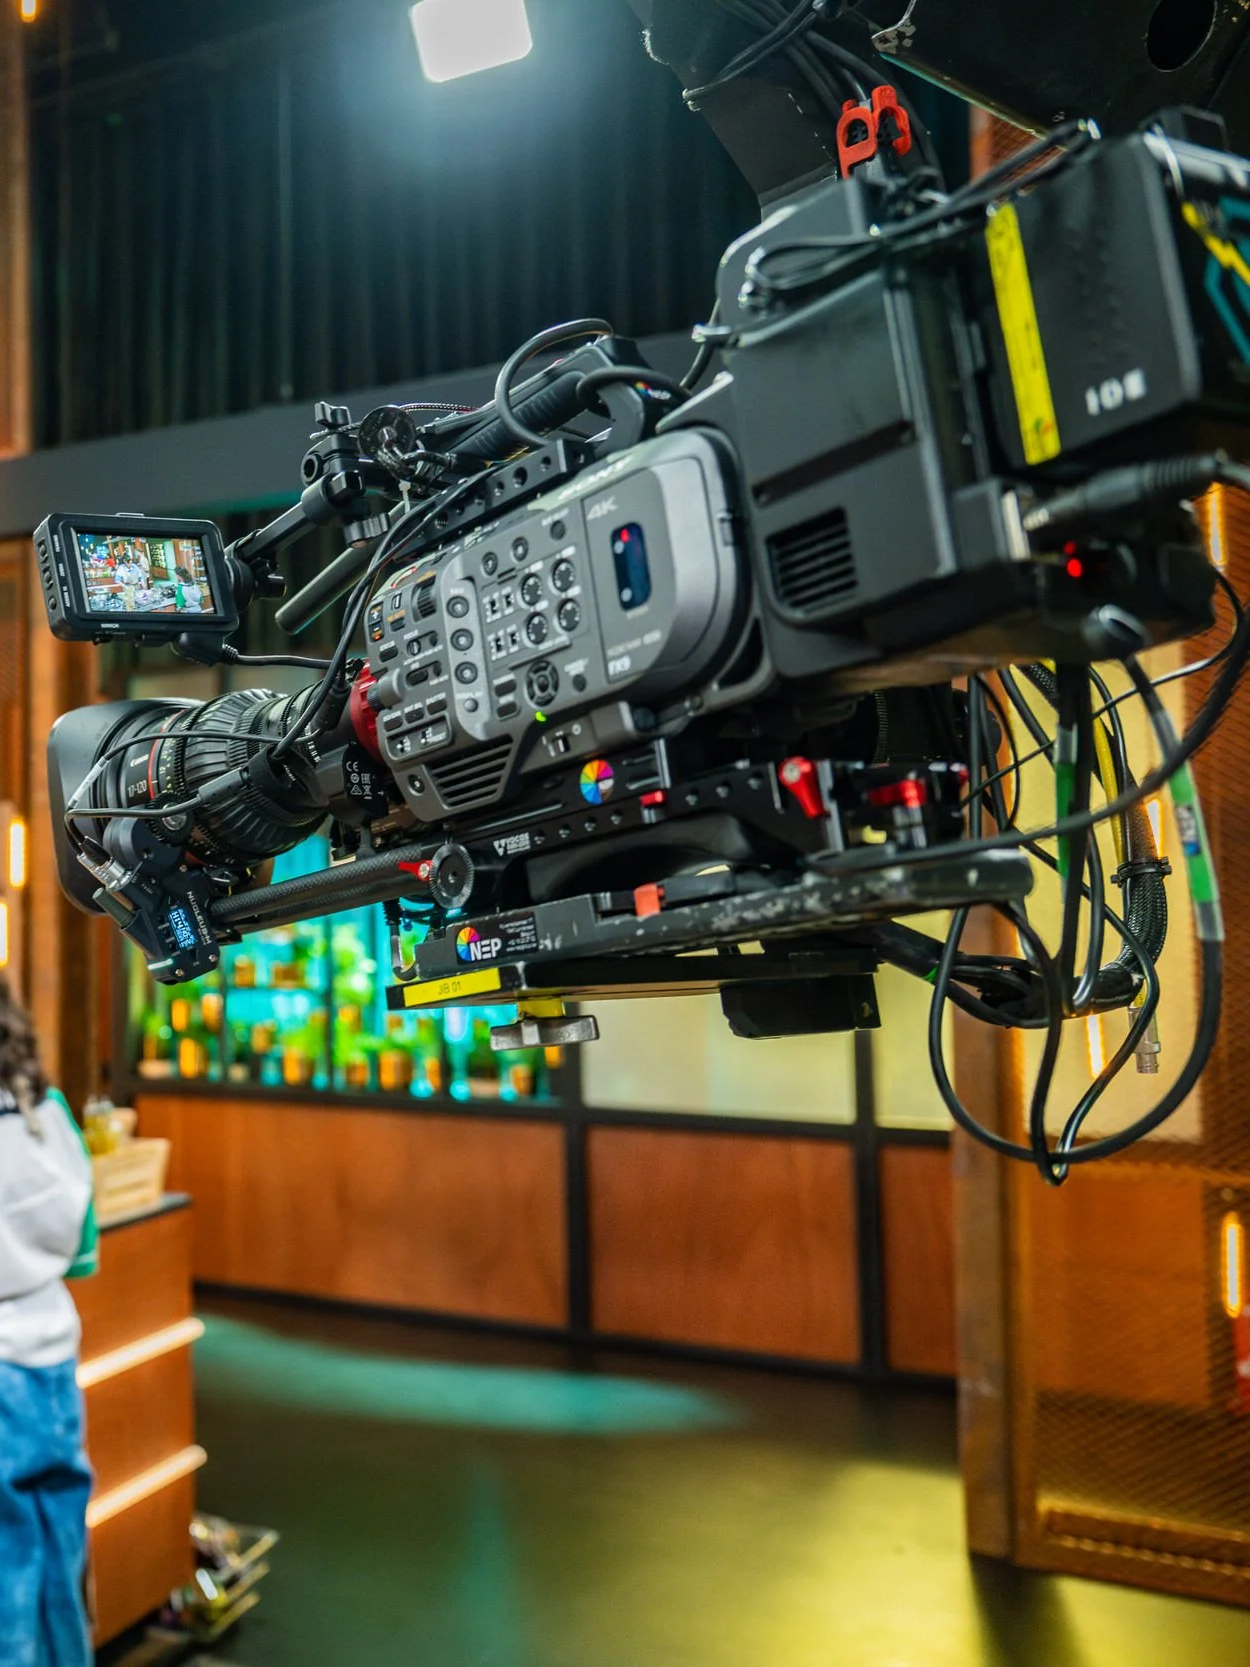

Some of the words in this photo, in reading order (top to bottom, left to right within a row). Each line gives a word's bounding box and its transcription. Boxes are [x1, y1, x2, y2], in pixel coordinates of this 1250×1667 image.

[586, 496, 618, 520] 4K
[608, 654, 631, 675] FX9
[127, 780, 147, 798] 17-120
[186, 891, 212, 945] NUCLEUS-M
[470, 937, 502, 962] NEP
[452, 980, 462, 992] 01
